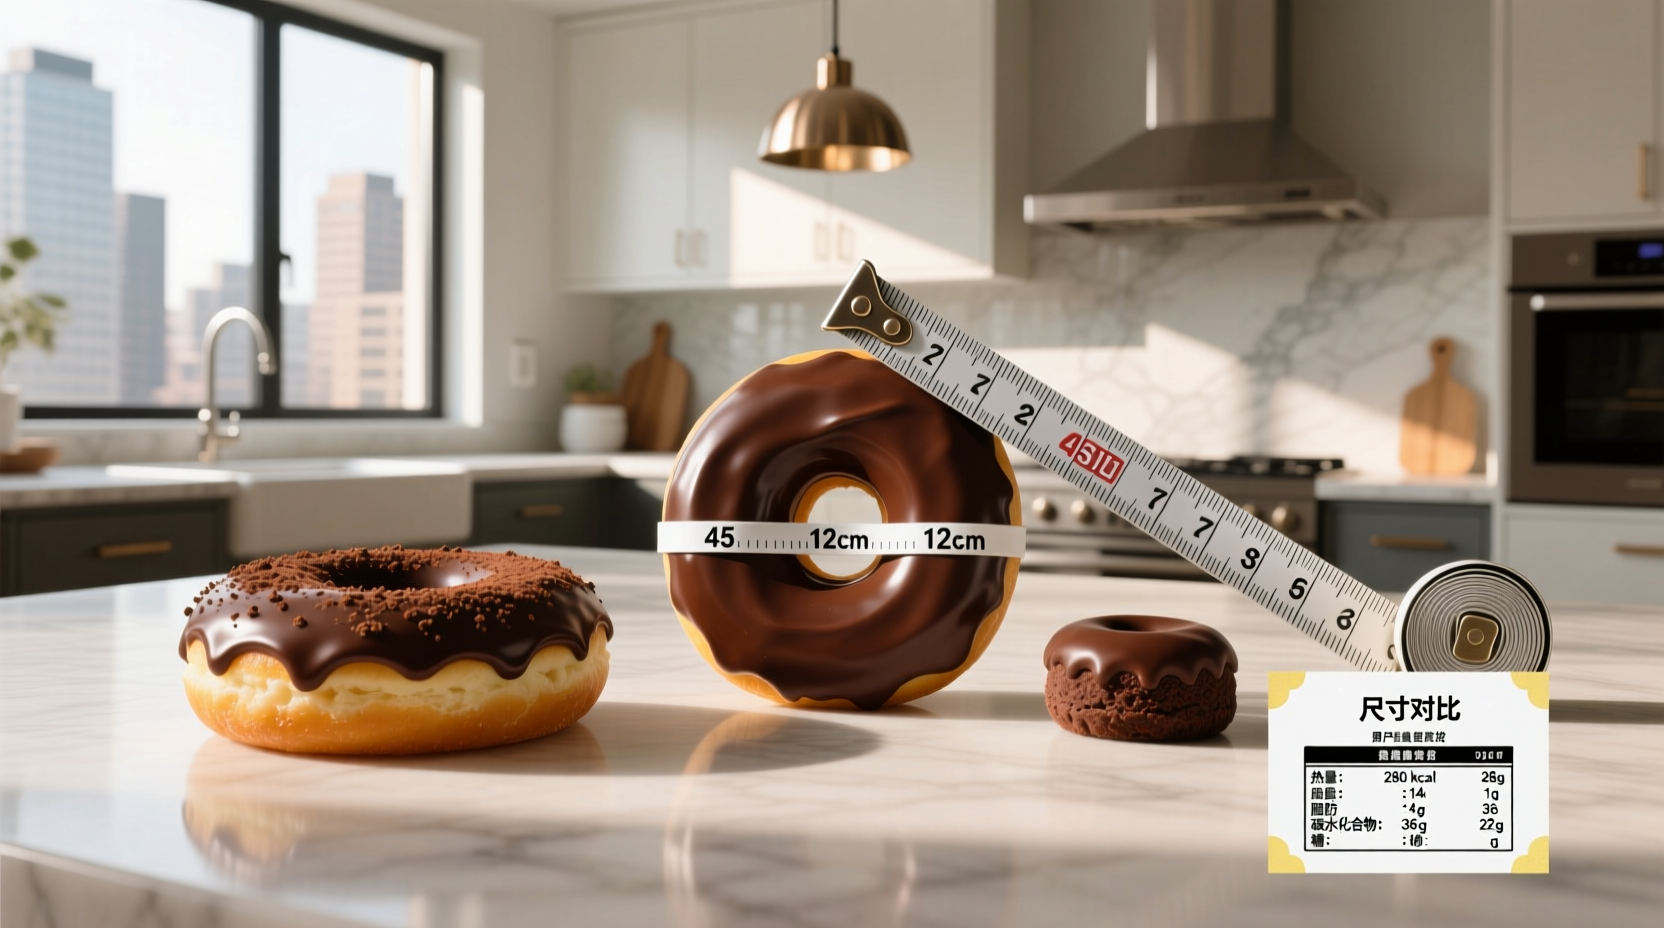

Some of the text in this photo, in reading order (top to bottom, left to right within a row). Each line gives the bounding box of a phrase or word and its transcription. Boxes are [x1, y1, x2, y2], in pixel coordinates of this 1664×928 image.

[1014, 404, 1035, 426] 2
[1147, 487, 1168, 510] 7
[1193, 516, 1214, 538] 7
[704, 526, 986, 550] 45 12cm 12cm
